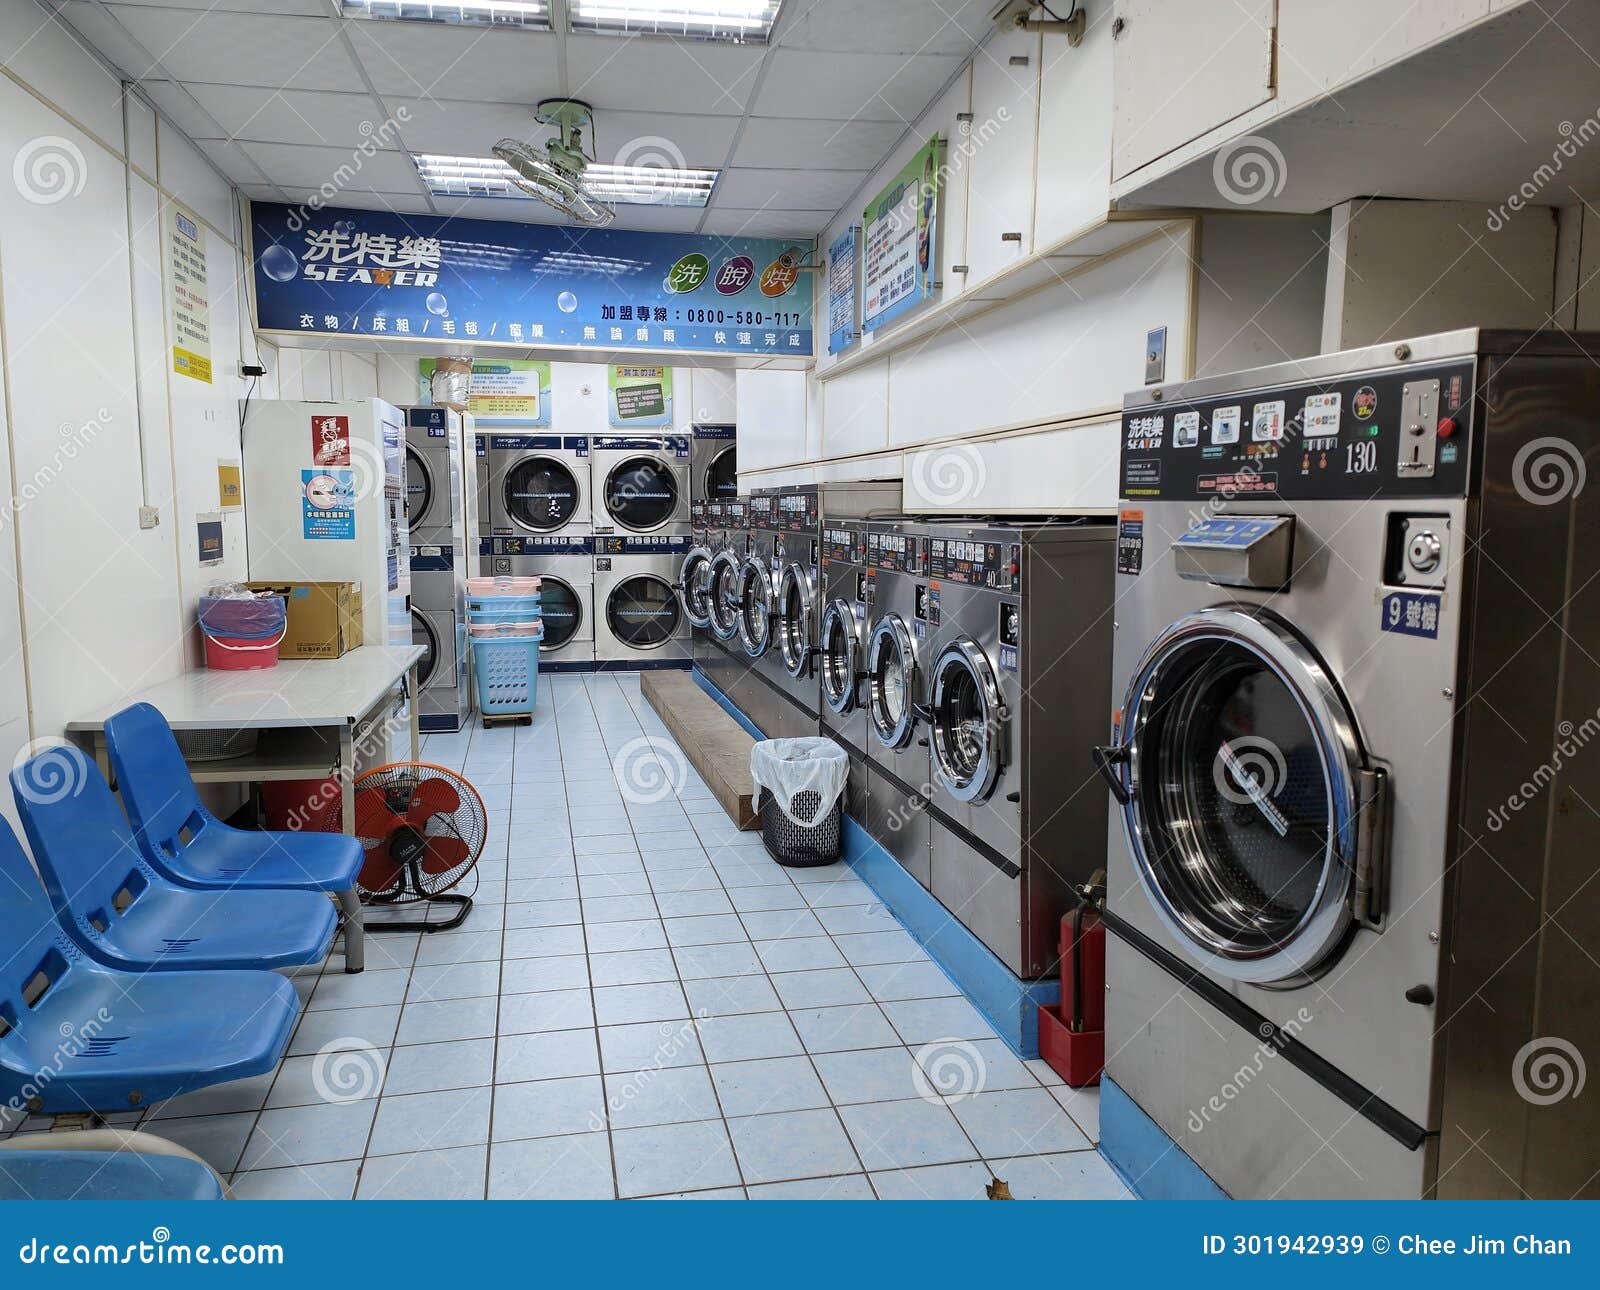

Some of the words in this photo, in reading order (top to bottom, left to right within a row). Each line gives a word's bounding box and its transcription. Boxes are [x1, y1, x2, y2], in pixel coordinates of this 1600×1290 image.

[302, 229, 442, 268] 洗特樂
[671, 263, 703, 285] 洗
[765, 267, 794, 290] 烘
[1128, 416, 1164, 438] 洗特樂
[1345, 441, 1376, 473] 130
